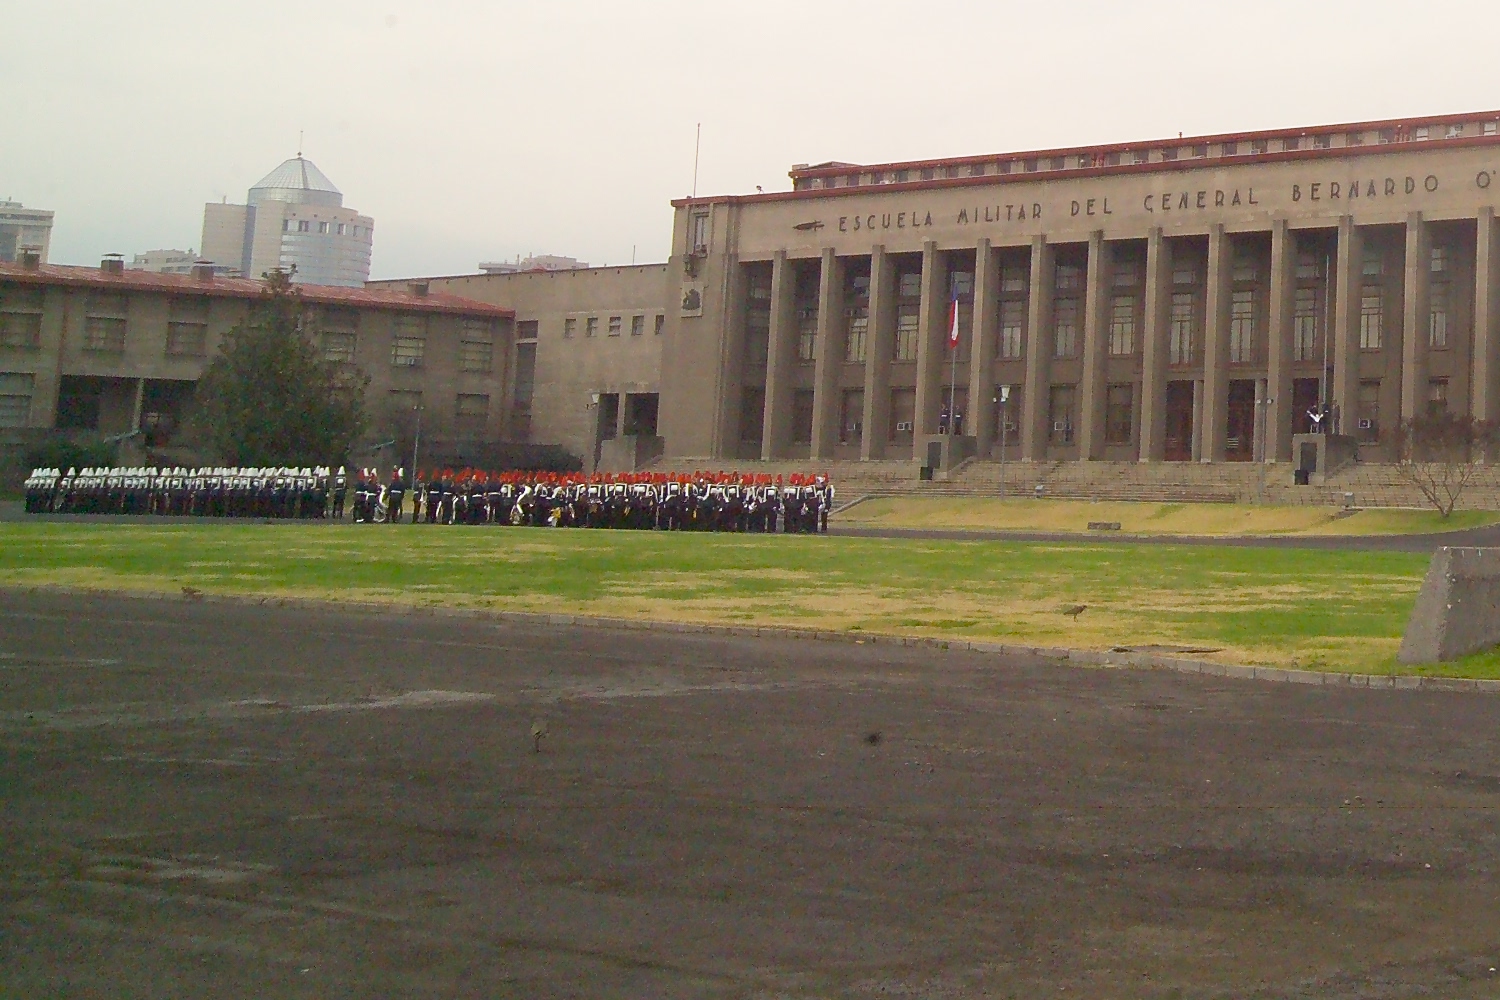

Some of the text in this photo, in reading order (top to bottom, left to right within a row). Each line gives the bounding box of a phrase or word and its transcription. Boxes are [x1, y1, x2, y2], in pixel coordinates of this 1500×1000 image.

[839, 210, 932, 232] ESCUELA
[957, 203, 1042, 224] MILITAR
[1070, 197, 1112, 217] DEL
[1144, 187, 1259, 213] GENERAL
[1292, 174, 1439, 202] BERNARDO
